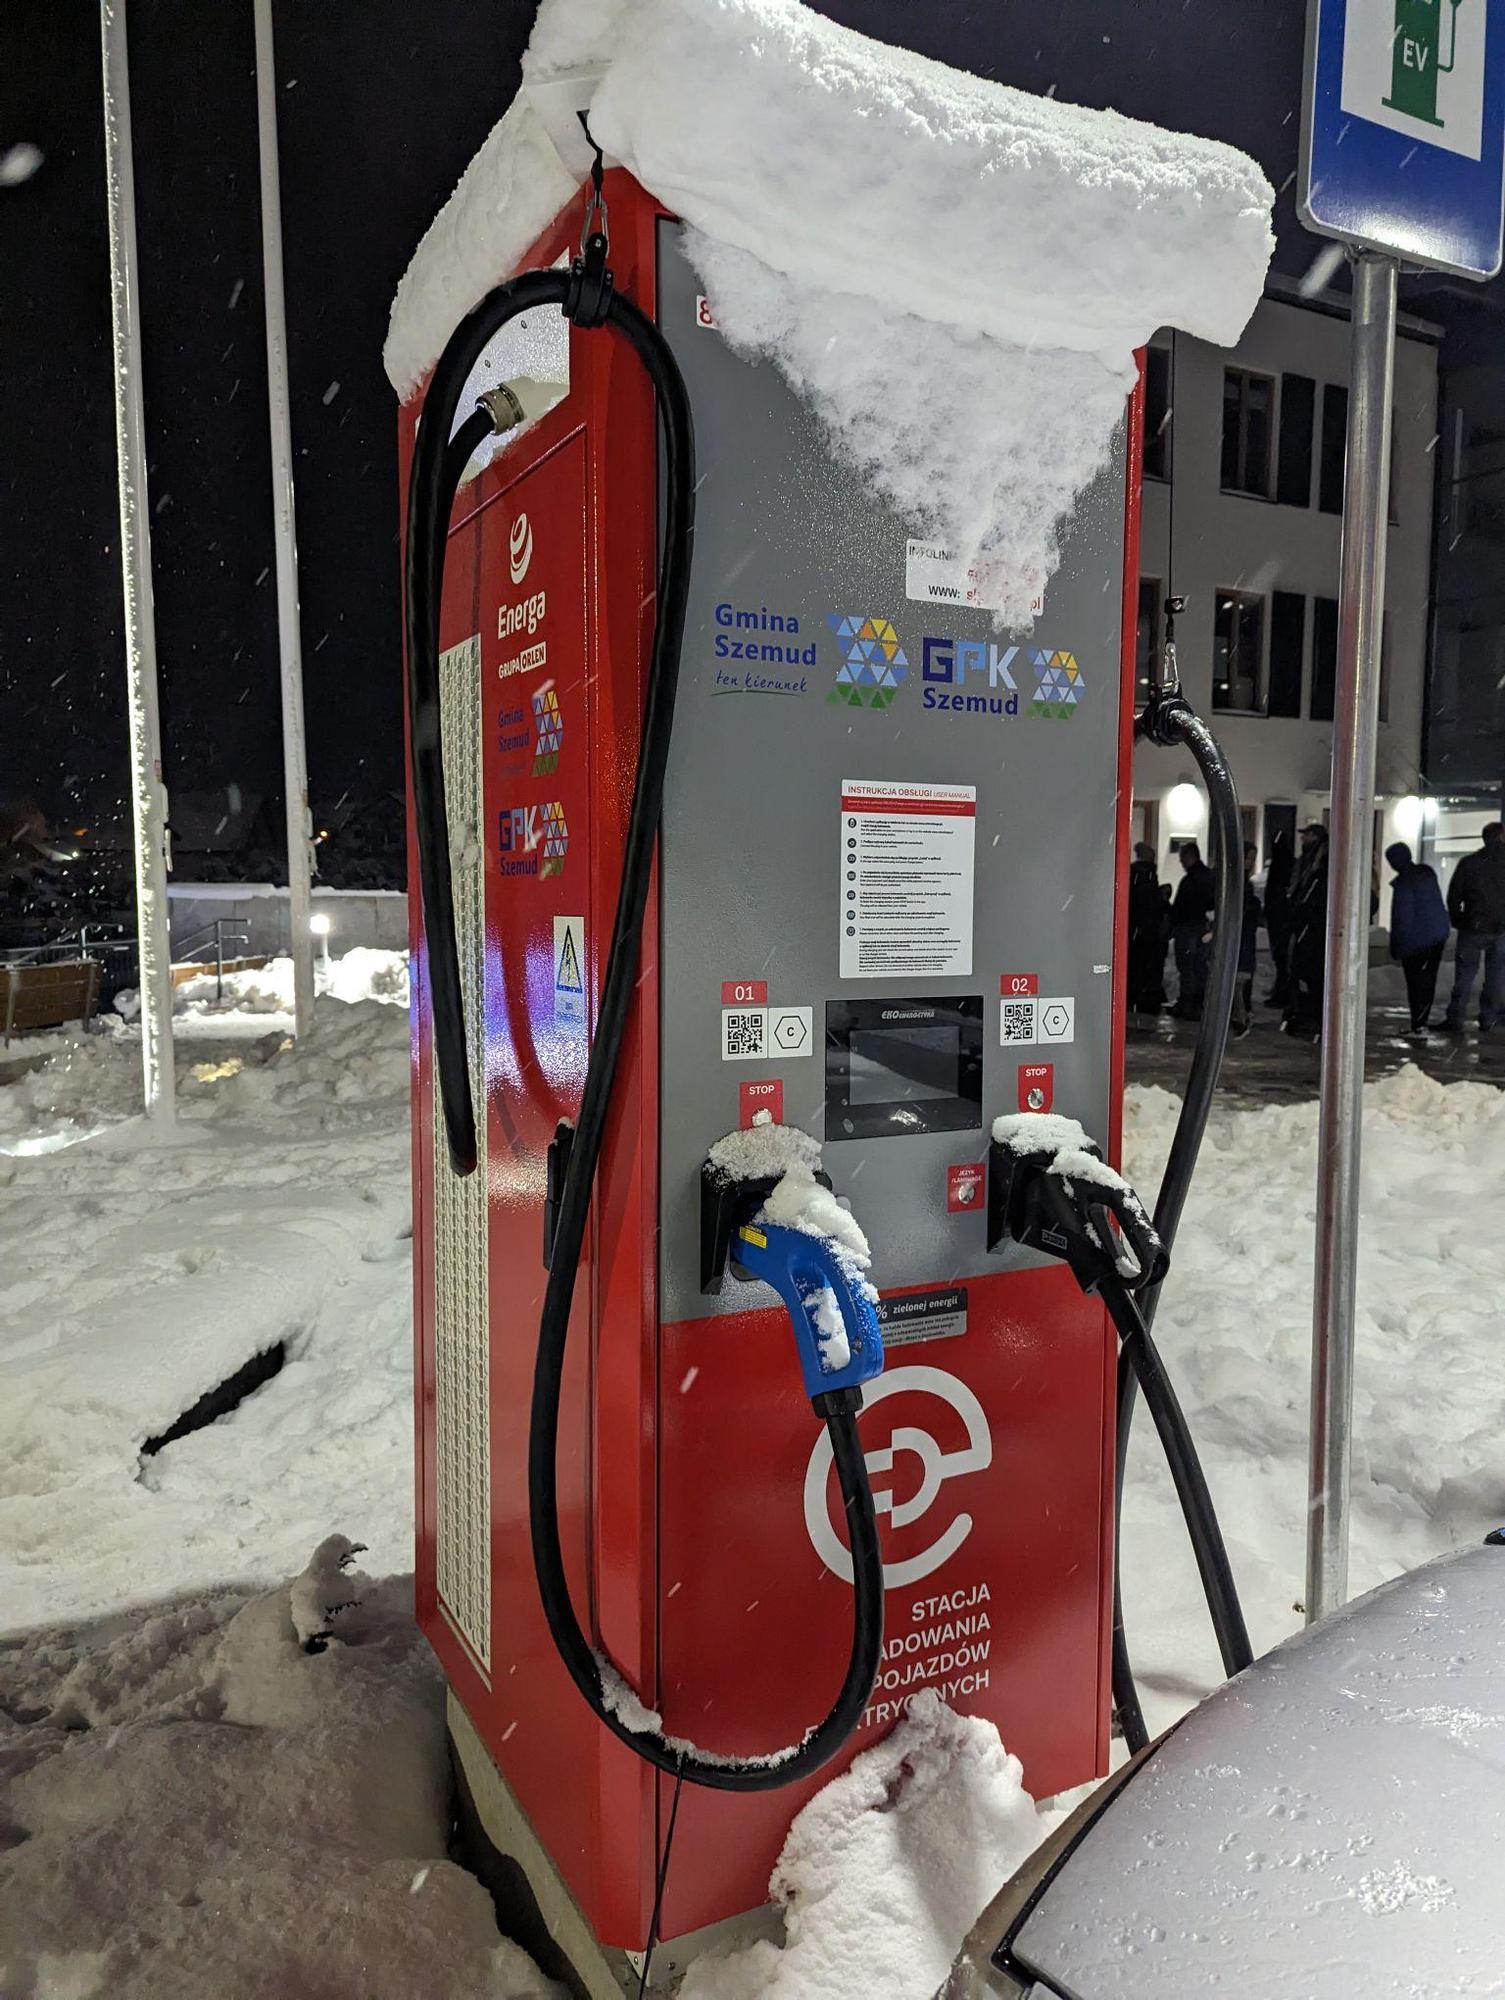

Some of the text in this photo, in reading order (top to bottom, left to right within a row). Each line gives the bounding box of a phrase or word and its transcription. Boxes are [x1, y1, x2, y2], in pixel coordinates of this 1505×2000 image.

[1402, 38, 1429, 72] EV
[498, 591, 546, 640] Energa
[715, 603, 799, 634] Gmina
[498, 644, 545, 679] GRUPA ORLEN
[715, 634, 817, 666] Szemud
[922, 637, 1019, 689] GPK
[922, 687, 1018, 715] Szemud
[498, 728, 530, 752] Szemud
[847, 786, 897, 796] INSTRUKCJA
[899, 787, 933, 797] OBSŁUGI
[498, 805, 538, 852] GPK
[500, 854, 538, 877] Szemud
[735, 985, 755, 1001] 01
[1011, 978, 1028, 992] 02
[786, 1026, 795, 1037] C
[1052, 1015, 1060, 1025] C
[1025, 1067, 1047, 1077] STOP
[749, 1084, 775, 1096] STOP
[893, 1300, 927, 1314] zielonej
[929, 1295, 958, 1308] energii
[911, 1583, 991, 1622] STACJA
[880, 1612, 991, 1661] ADOWANIA
